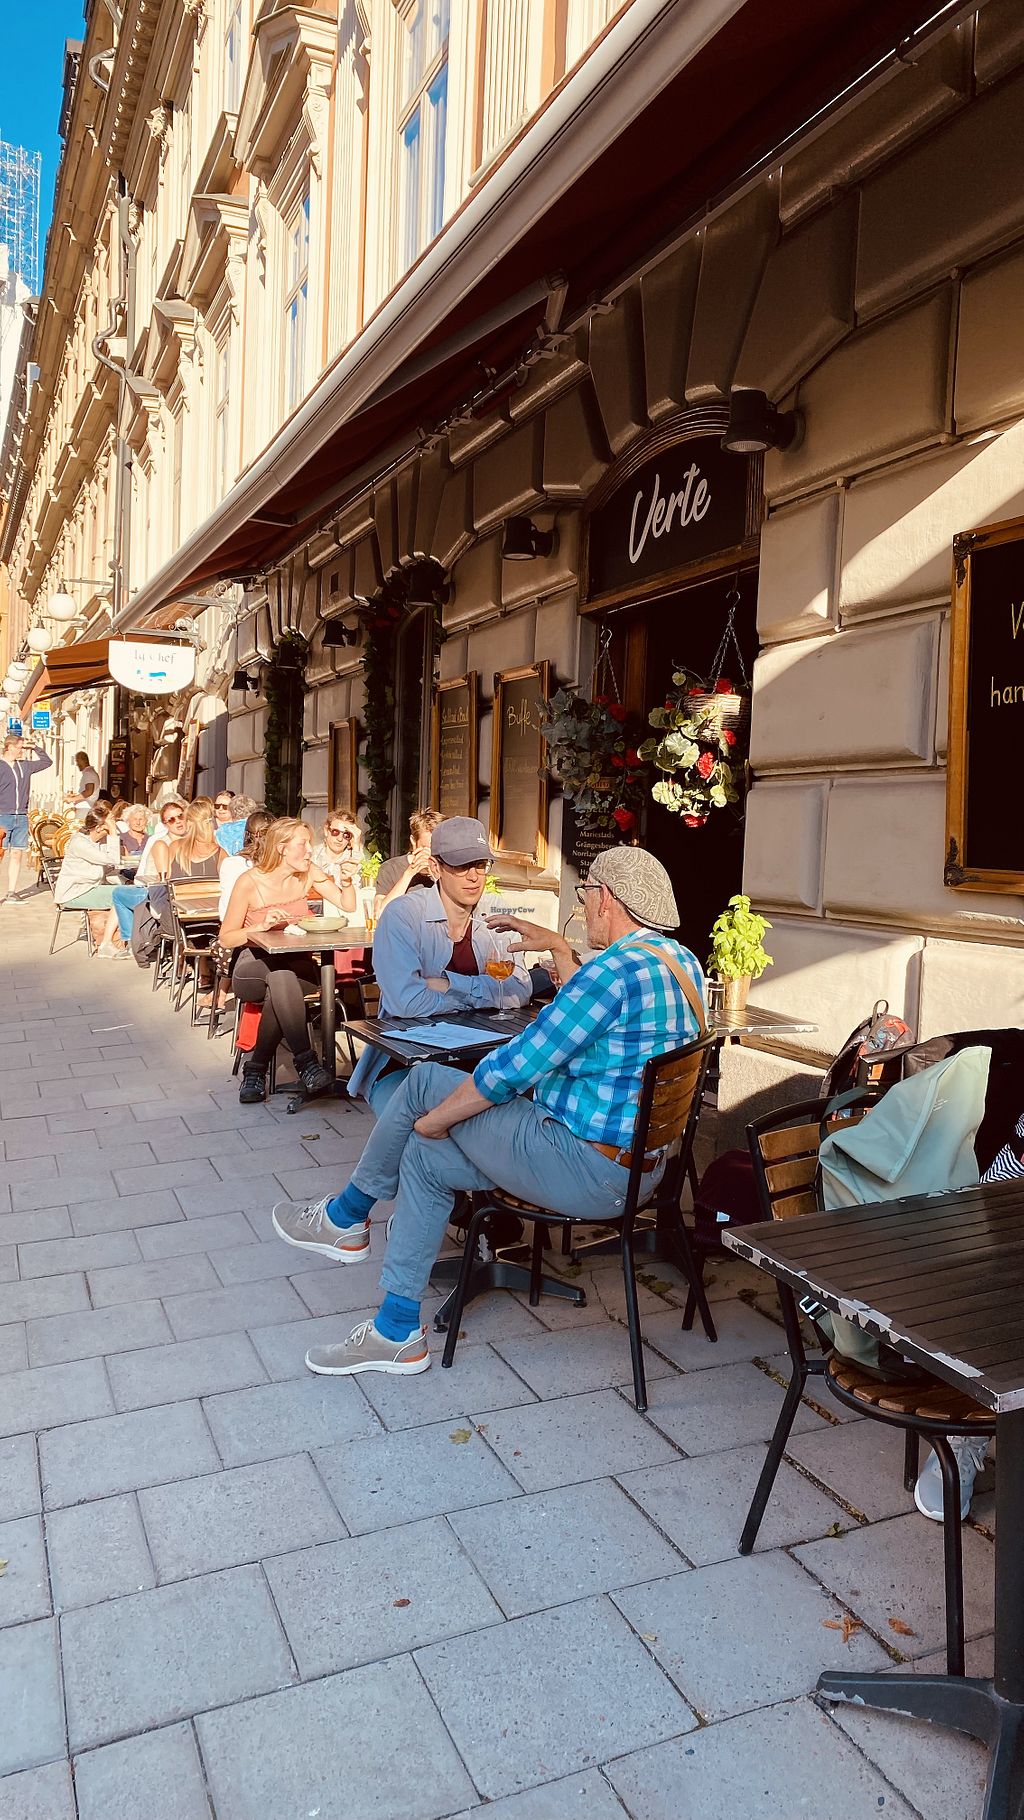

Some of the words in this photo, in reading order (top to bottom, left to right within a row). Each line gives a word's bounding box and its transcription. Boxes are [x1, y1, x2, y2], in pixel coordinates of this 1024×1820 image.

[628, 463, 712, 564] Verte
[1011, 602, 1024, 639] V
[580, 831, 615, 839] Mariestads
